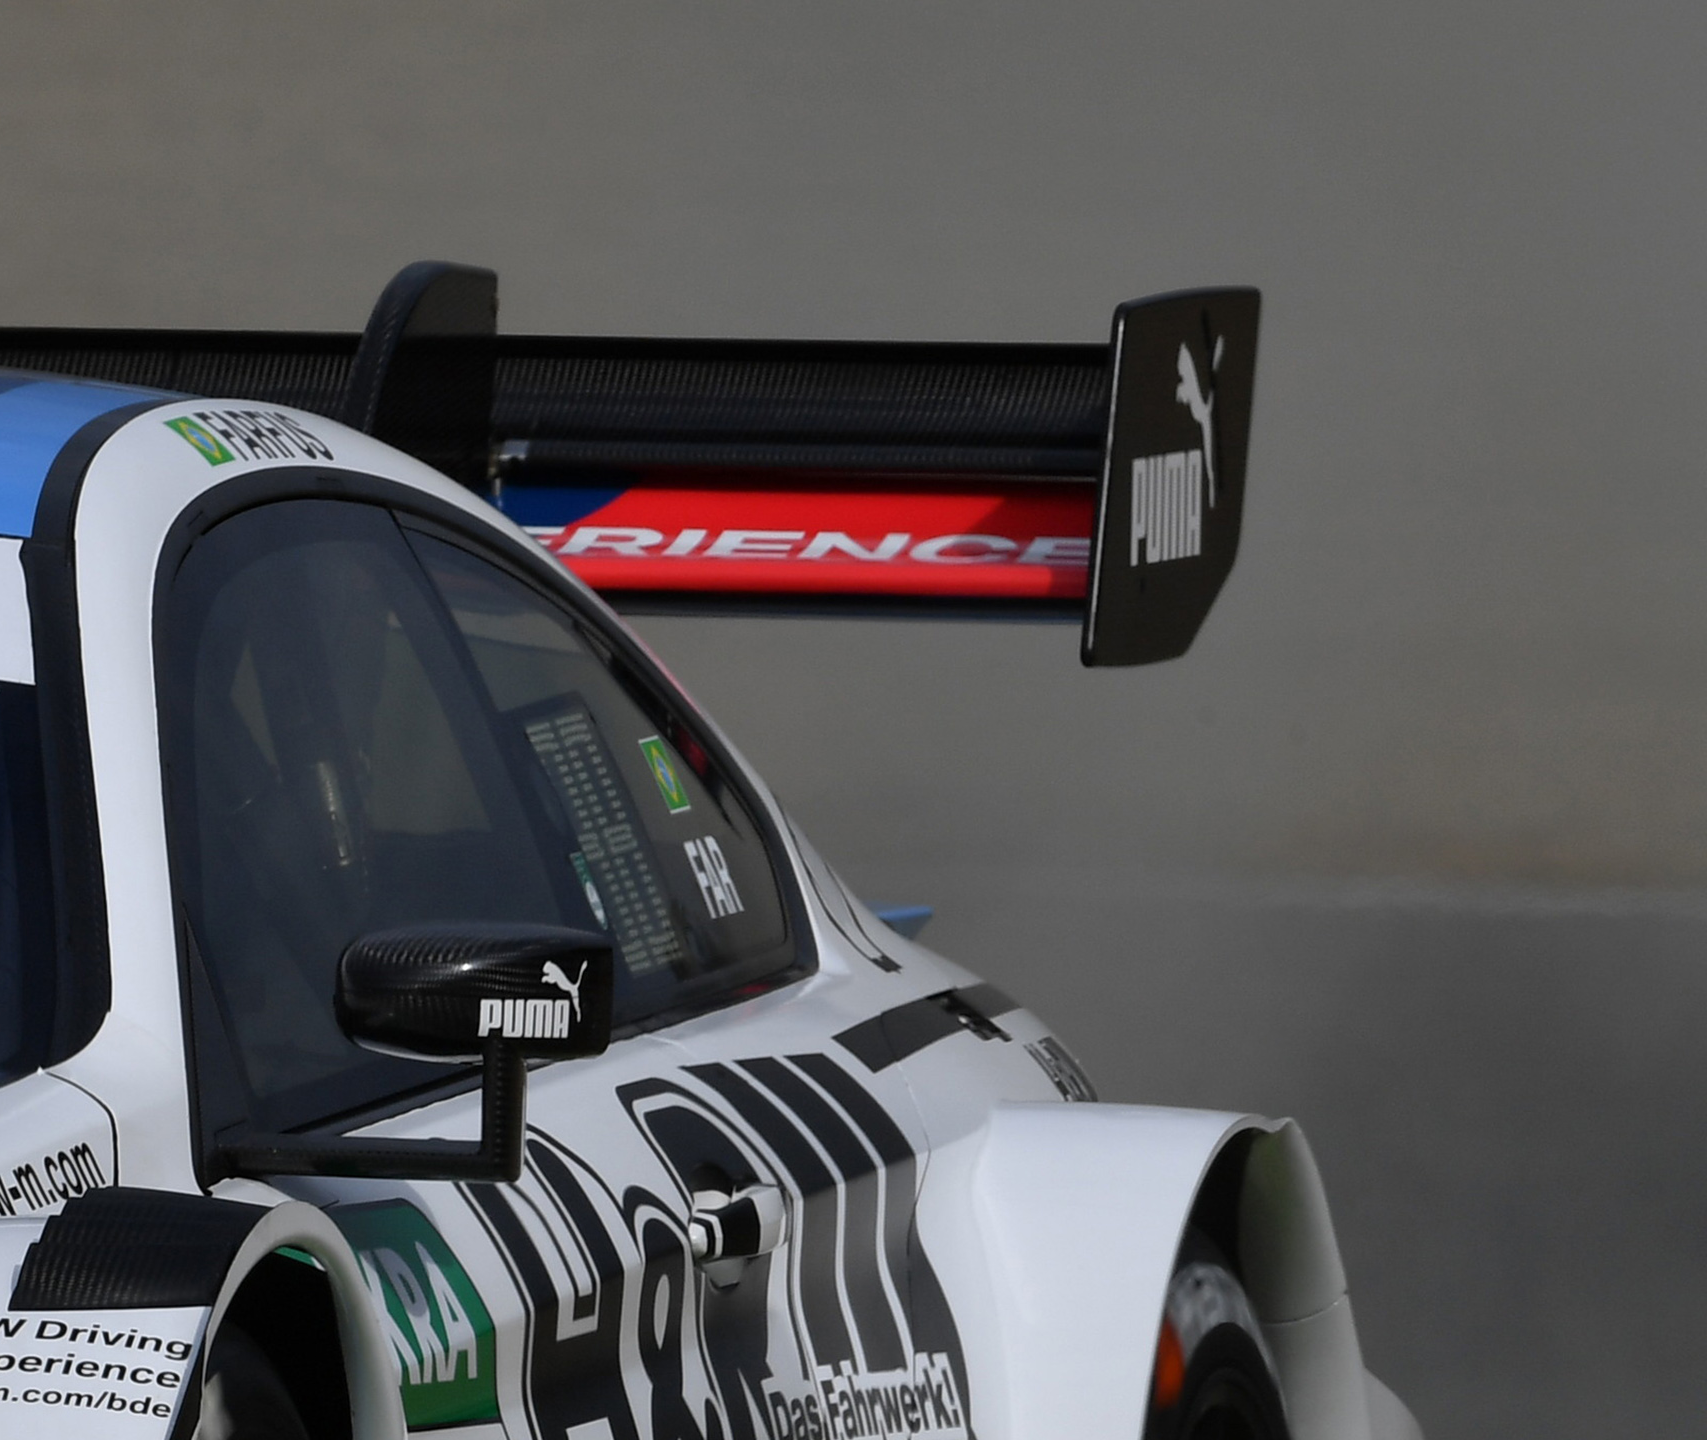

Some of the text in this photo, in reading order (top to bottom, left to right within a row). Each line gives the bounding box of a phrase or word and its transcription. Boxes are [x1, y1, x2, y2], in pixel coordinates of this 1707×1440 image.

[193, 410, 335, 462] FARFUS
[1131, 450, 1203, 567] PUMA
[683, 836, 745, 919] FAR
[477, 999, 571, 1039] PUMA
[35, 1320, 194, 1361] Driving
[819, 1366, 961, 1440] Fahrwerk!
